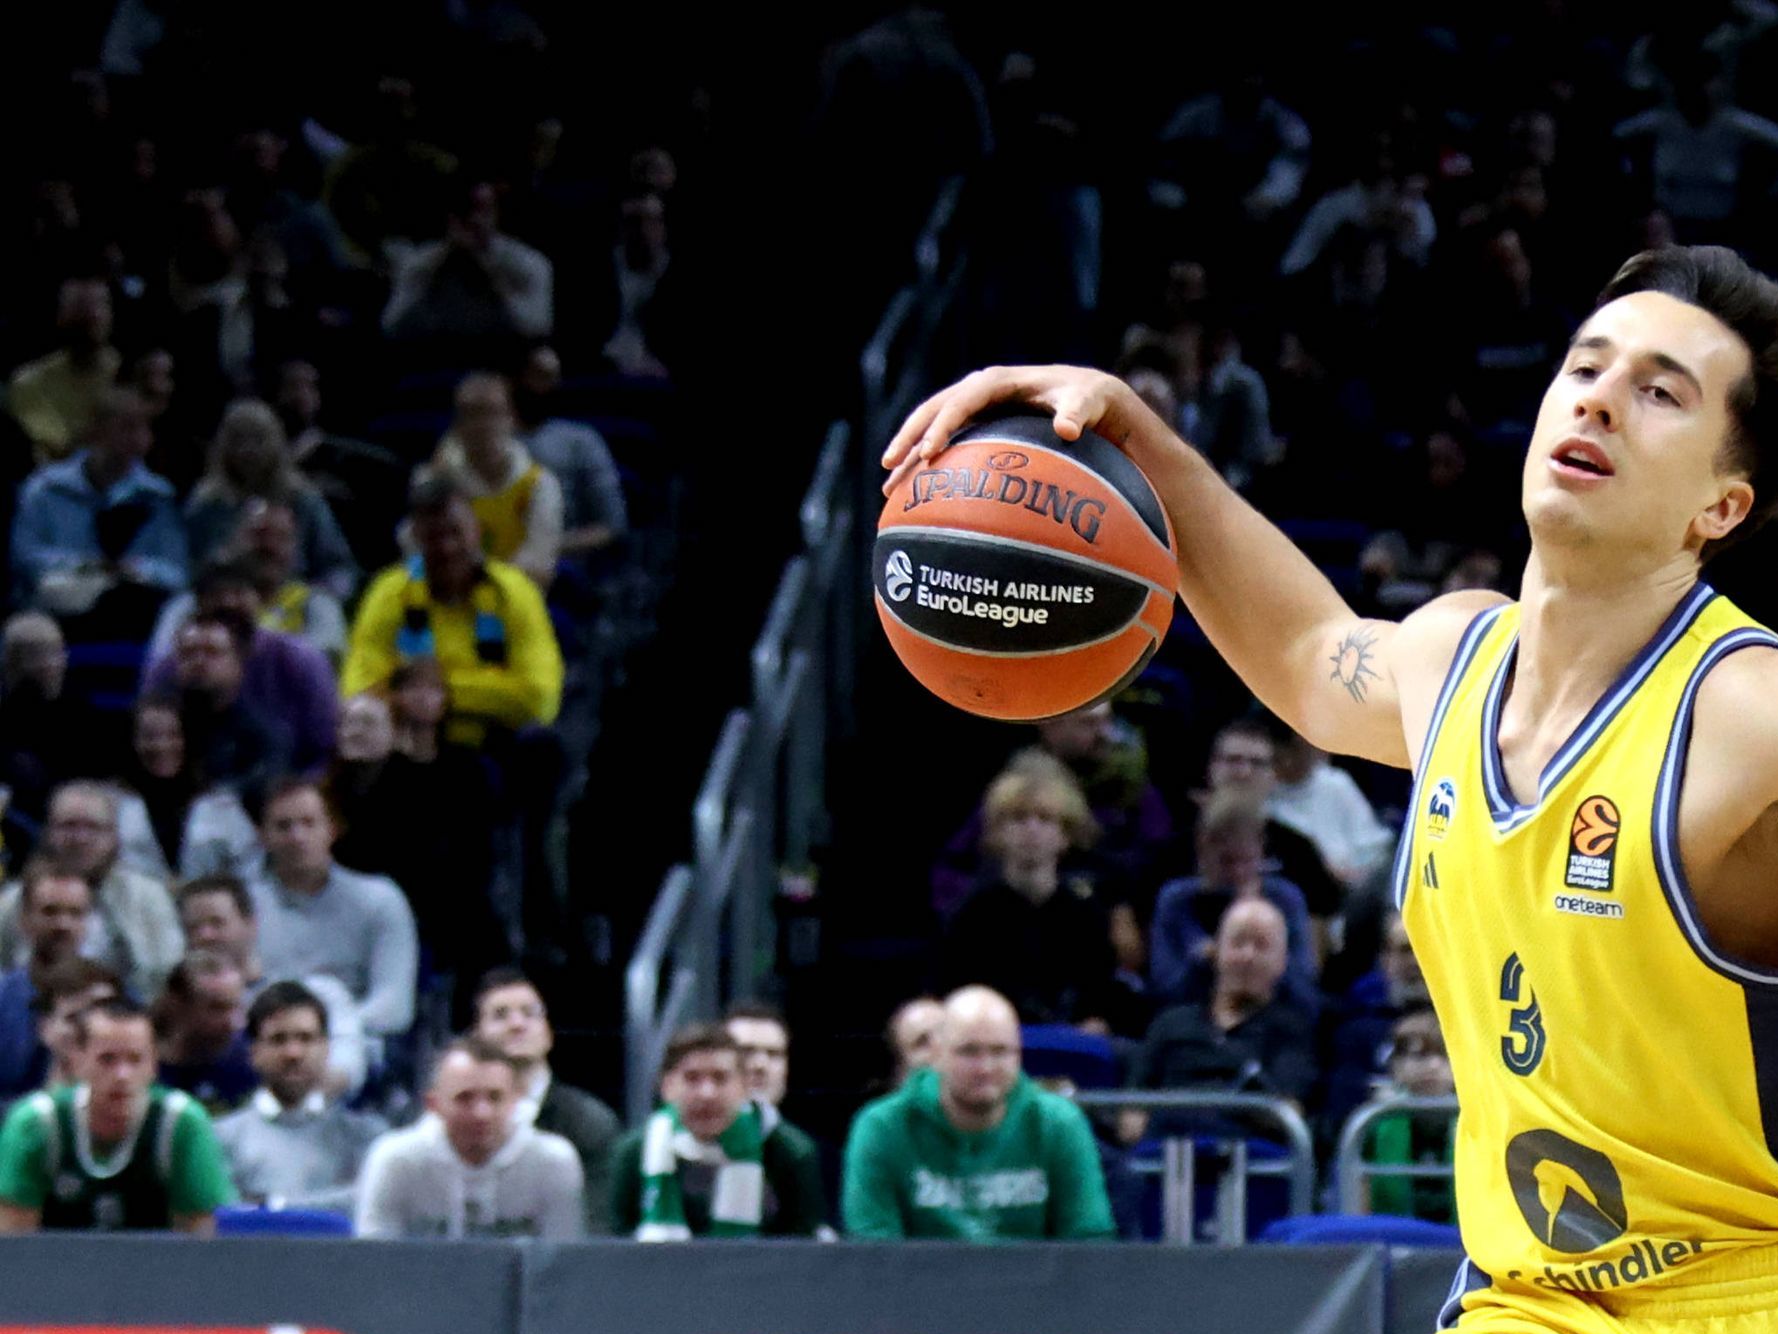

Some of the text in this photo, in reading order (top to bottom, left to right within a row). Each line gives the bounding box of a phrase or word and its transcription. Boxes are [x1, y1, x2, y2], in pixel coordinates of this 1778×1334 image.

[904, 469, 1105, 544] SPALDING
[919, 565, 1094, 604] TURKISH AIRLINES
[916, 588, 1049, 628] EuroLeague
[1555, 896, 1623, 915] oneteam
[1499, 950, 1547, 1077] 3
